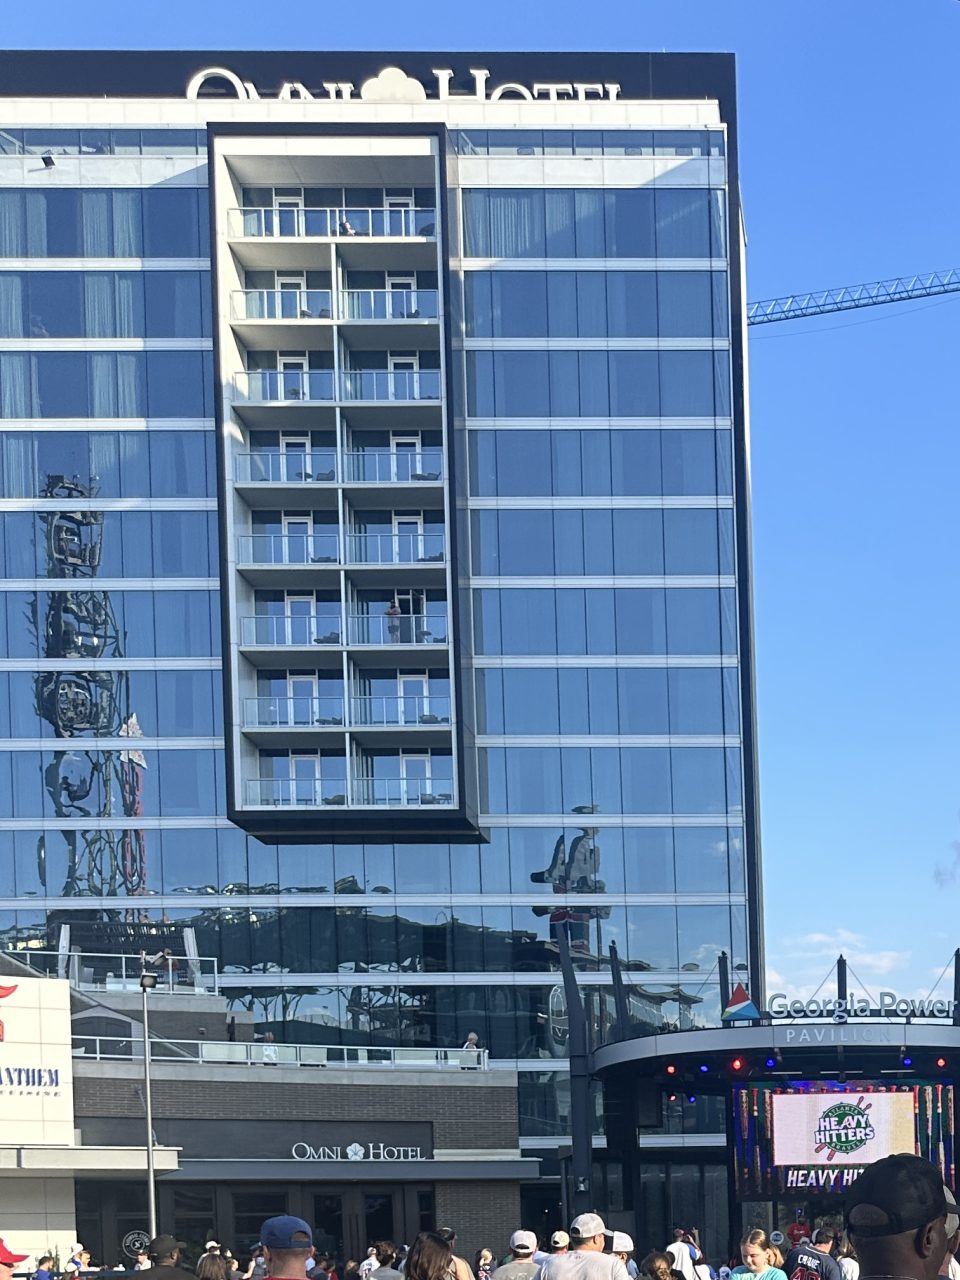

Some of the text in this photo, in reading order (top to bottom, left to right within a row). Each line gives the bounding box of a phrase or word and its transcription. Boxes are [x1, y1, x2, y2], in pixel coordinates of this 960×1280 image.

[768, 992, 958, 1023] Georgia Power
[786, 1028, 892, 1043] PAVILION
[0, 1067, 59, 1087] NTHEM
[819, 1114, 869, 1131] HEAVY
[814, 1127, 875, 1144] HITTERS
[292, 1142, 426, 1160] OMNI HOTEL
[787, 1169, 839, 1187] HEAVY
